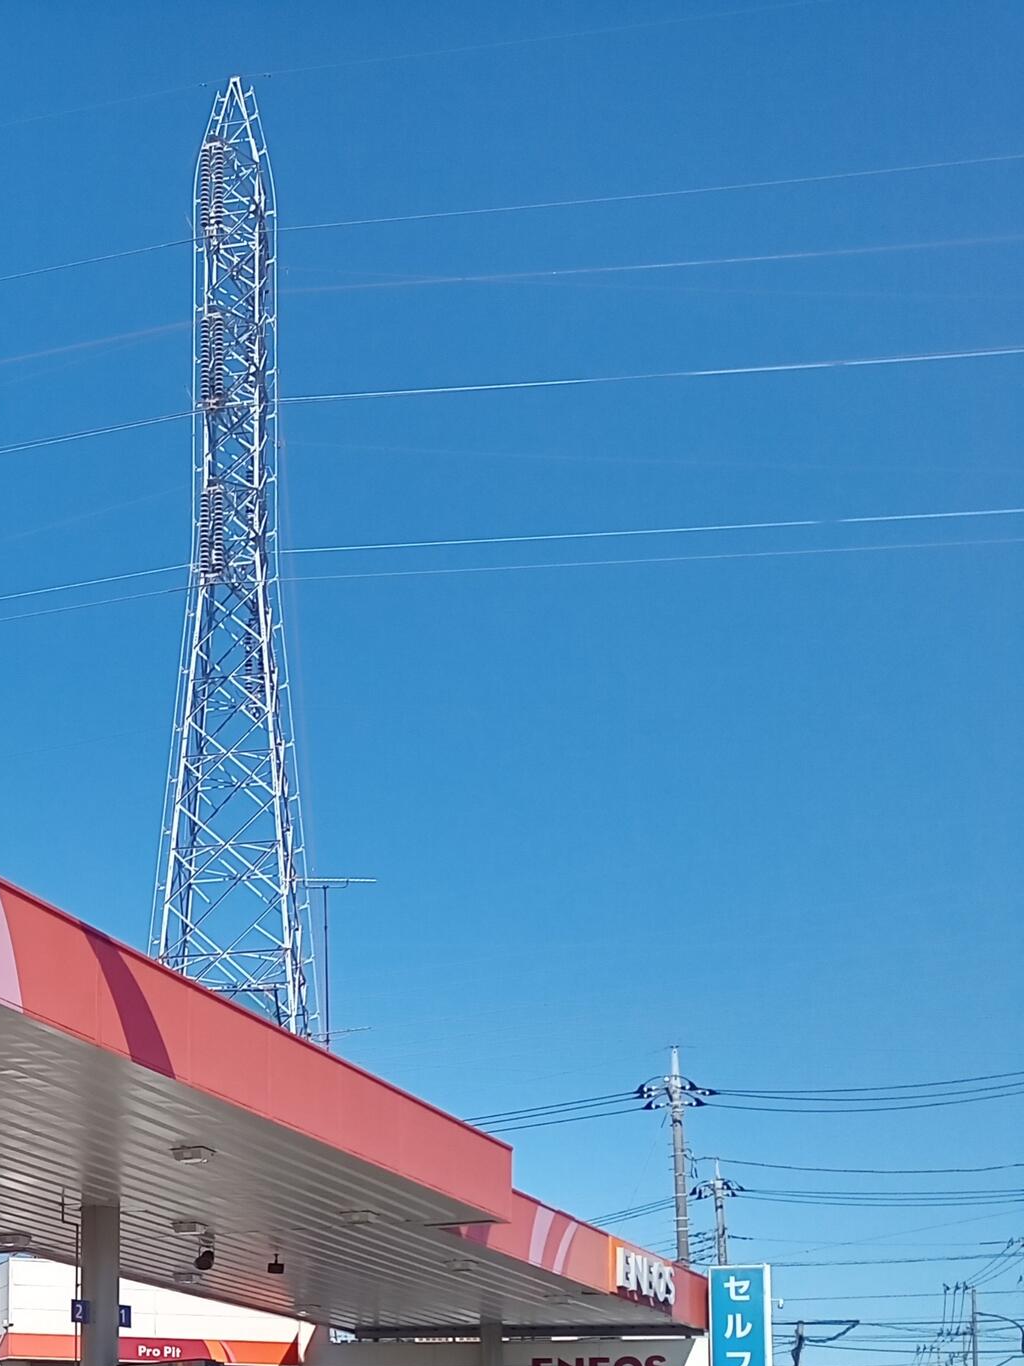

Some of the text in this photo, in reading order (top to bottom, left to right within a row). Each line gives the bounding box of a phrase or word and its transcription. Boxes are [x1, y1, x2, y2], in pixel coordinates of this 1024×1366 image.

[616, 1247, 675, 1305] ENEOS
[76, 1304, 83, 1319] 2
[120, 1309, 125, 1323] 1
[138, 1345, 181, 1358] Pro Pit
